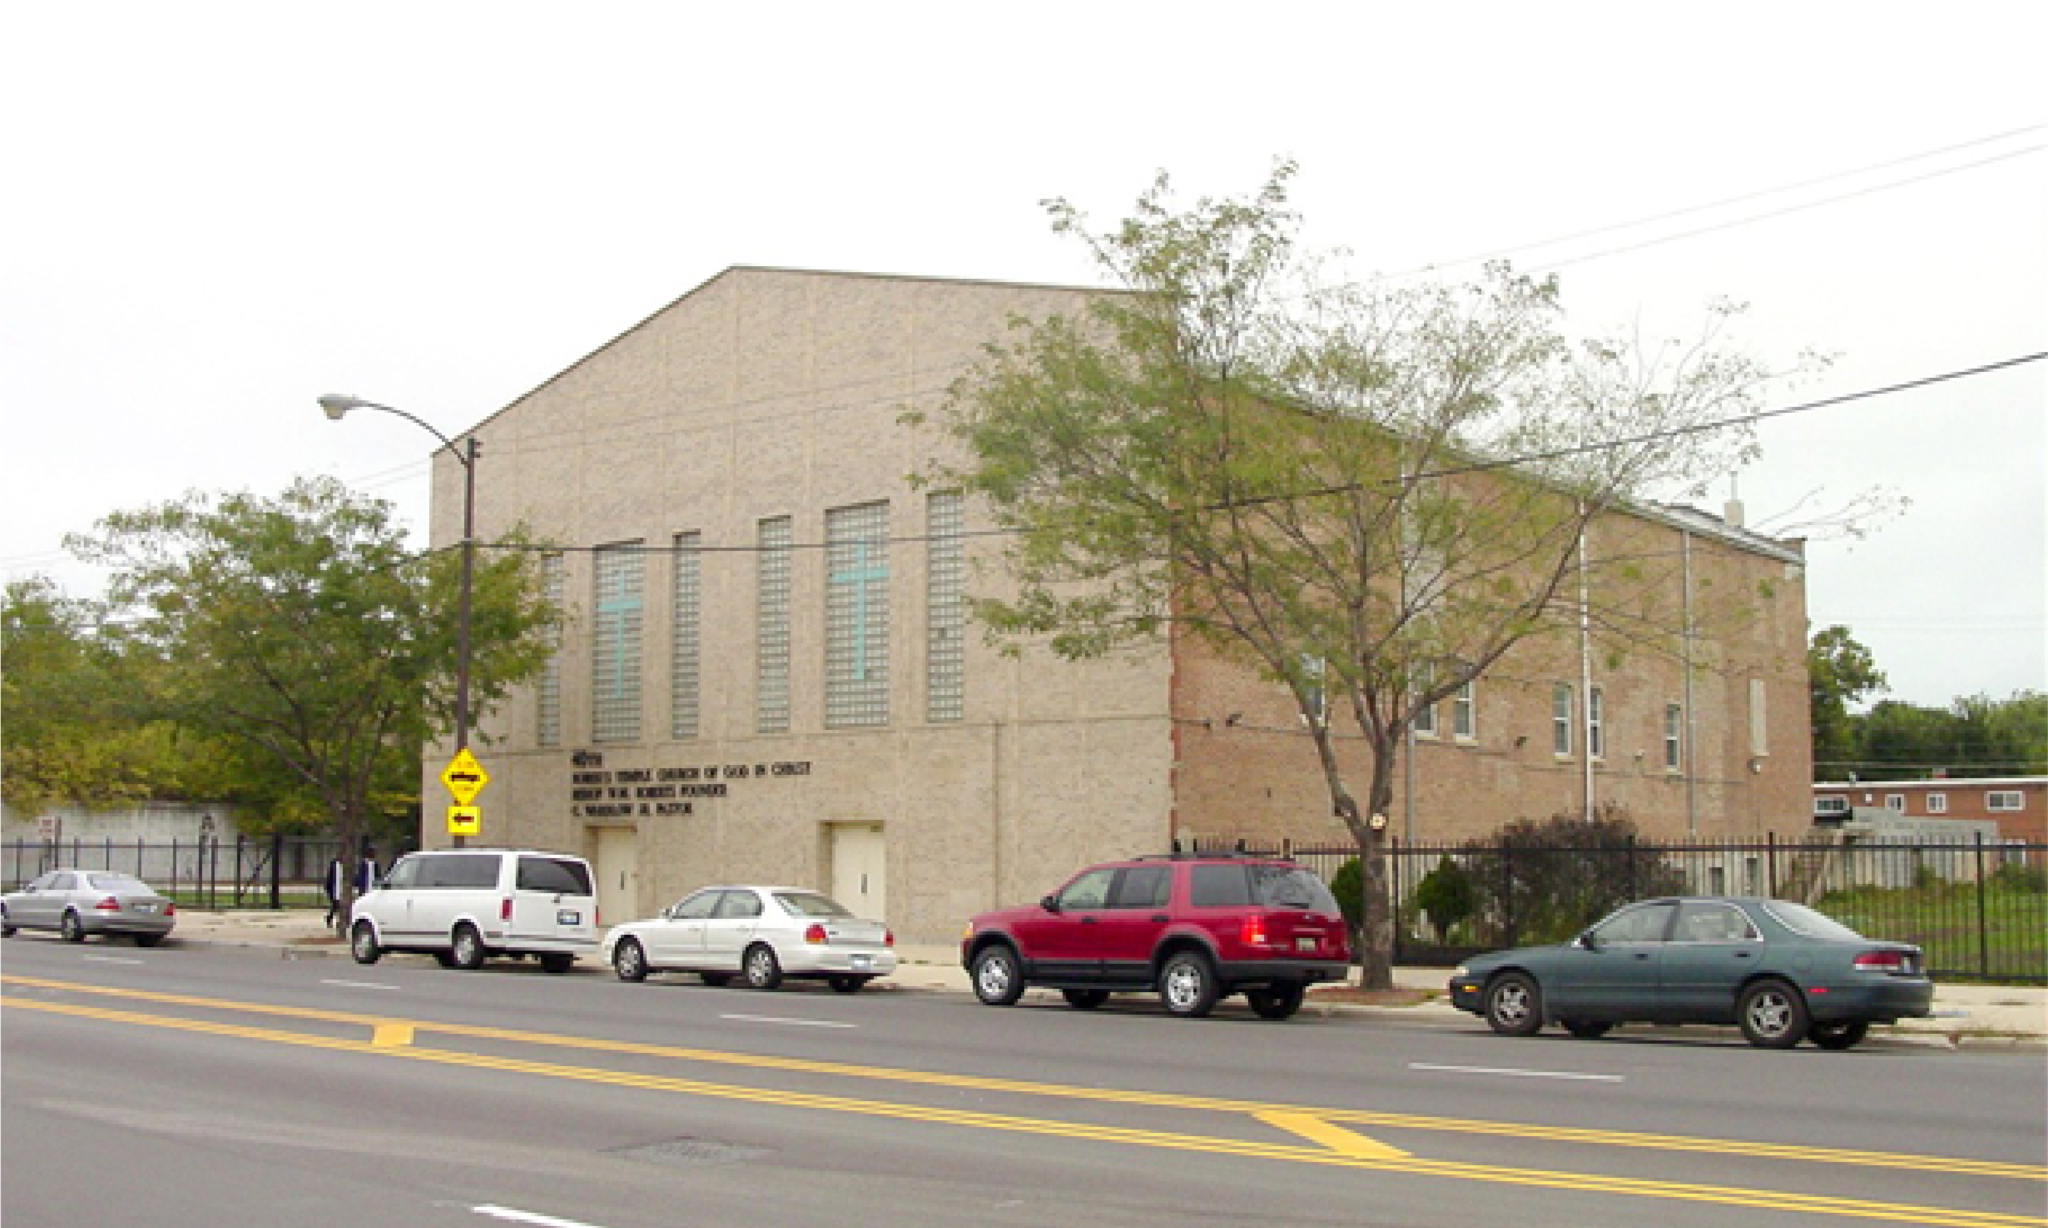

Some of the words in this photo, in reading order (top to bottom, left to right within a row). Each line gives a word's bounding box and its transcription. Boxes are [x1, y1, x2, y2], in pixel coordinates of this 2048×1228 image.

[704, 765, 717, 778] OF
[723, 765, 749, 778] GOD
[771, 761, 810, 776] CHRIST
